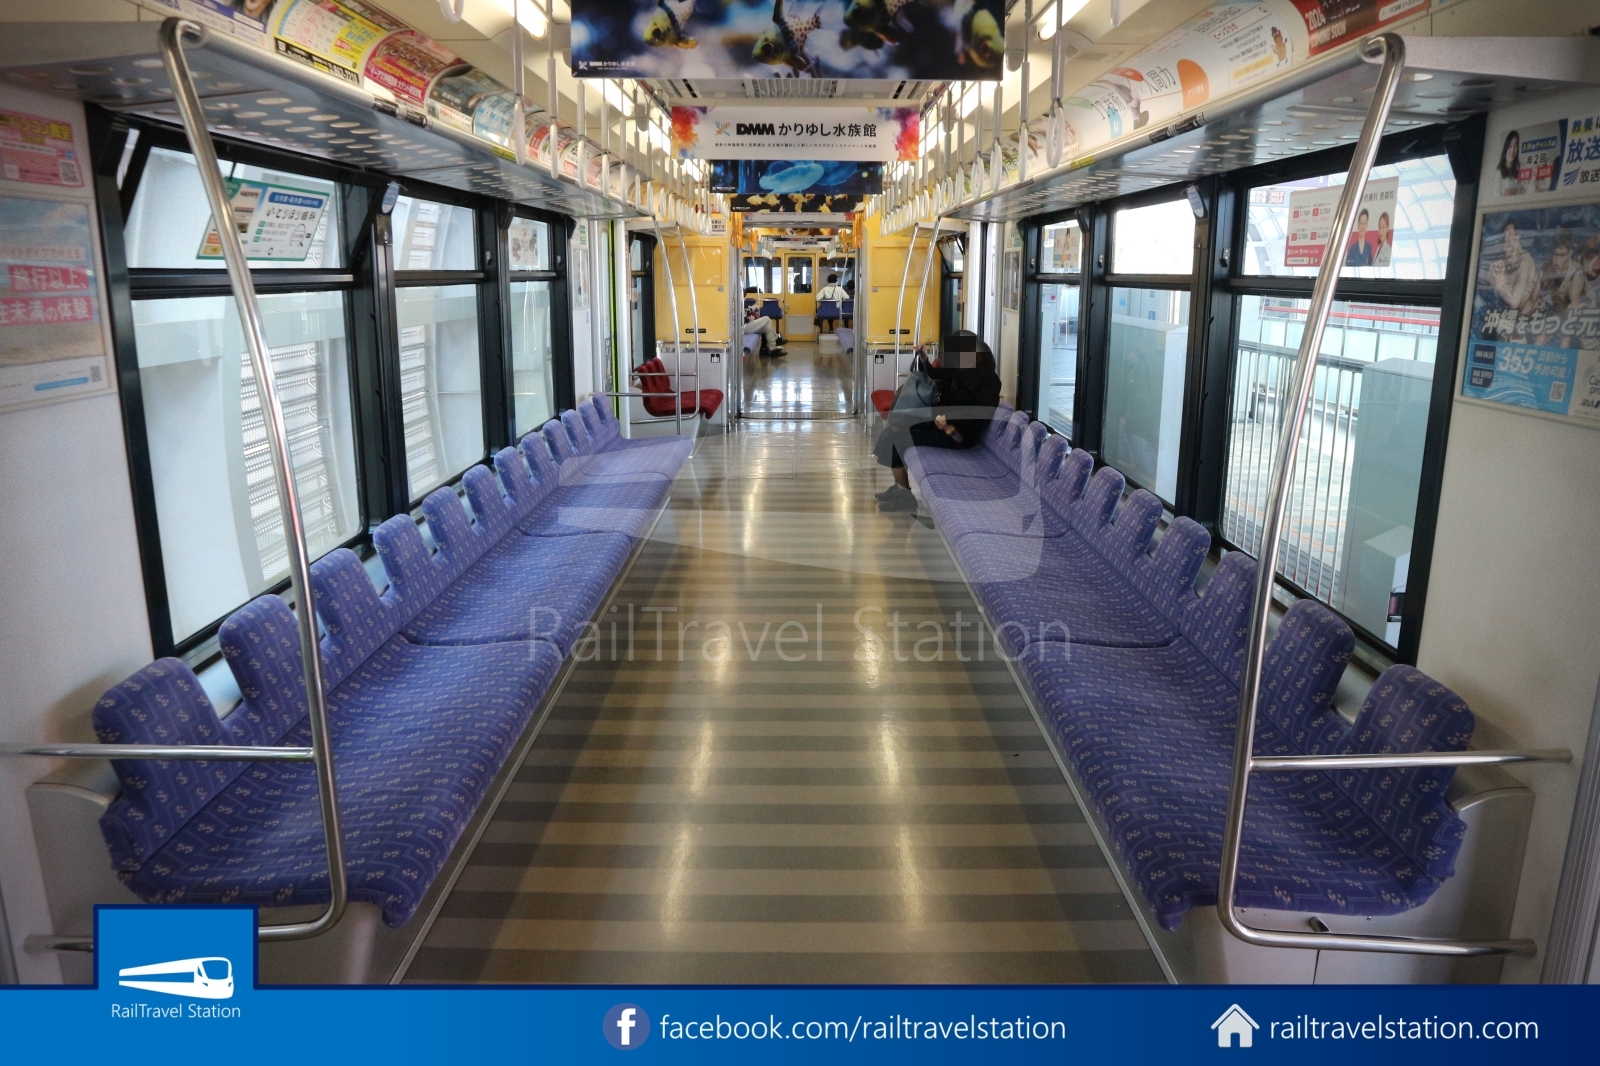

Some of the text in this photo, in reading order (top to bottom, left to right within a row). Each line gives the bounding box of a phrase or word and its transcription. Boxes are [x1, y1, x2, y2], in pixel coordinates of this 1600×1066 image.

[1305, 7, 1326, 31] 2024
[1331, 20, 1347, 39] SOON
[736, 122, 877, 138] DMM かりゆし水族館
[1482, 308, 1600, 337] 沖縄をもっと元
[1498, 346, 1538, 375] 355
